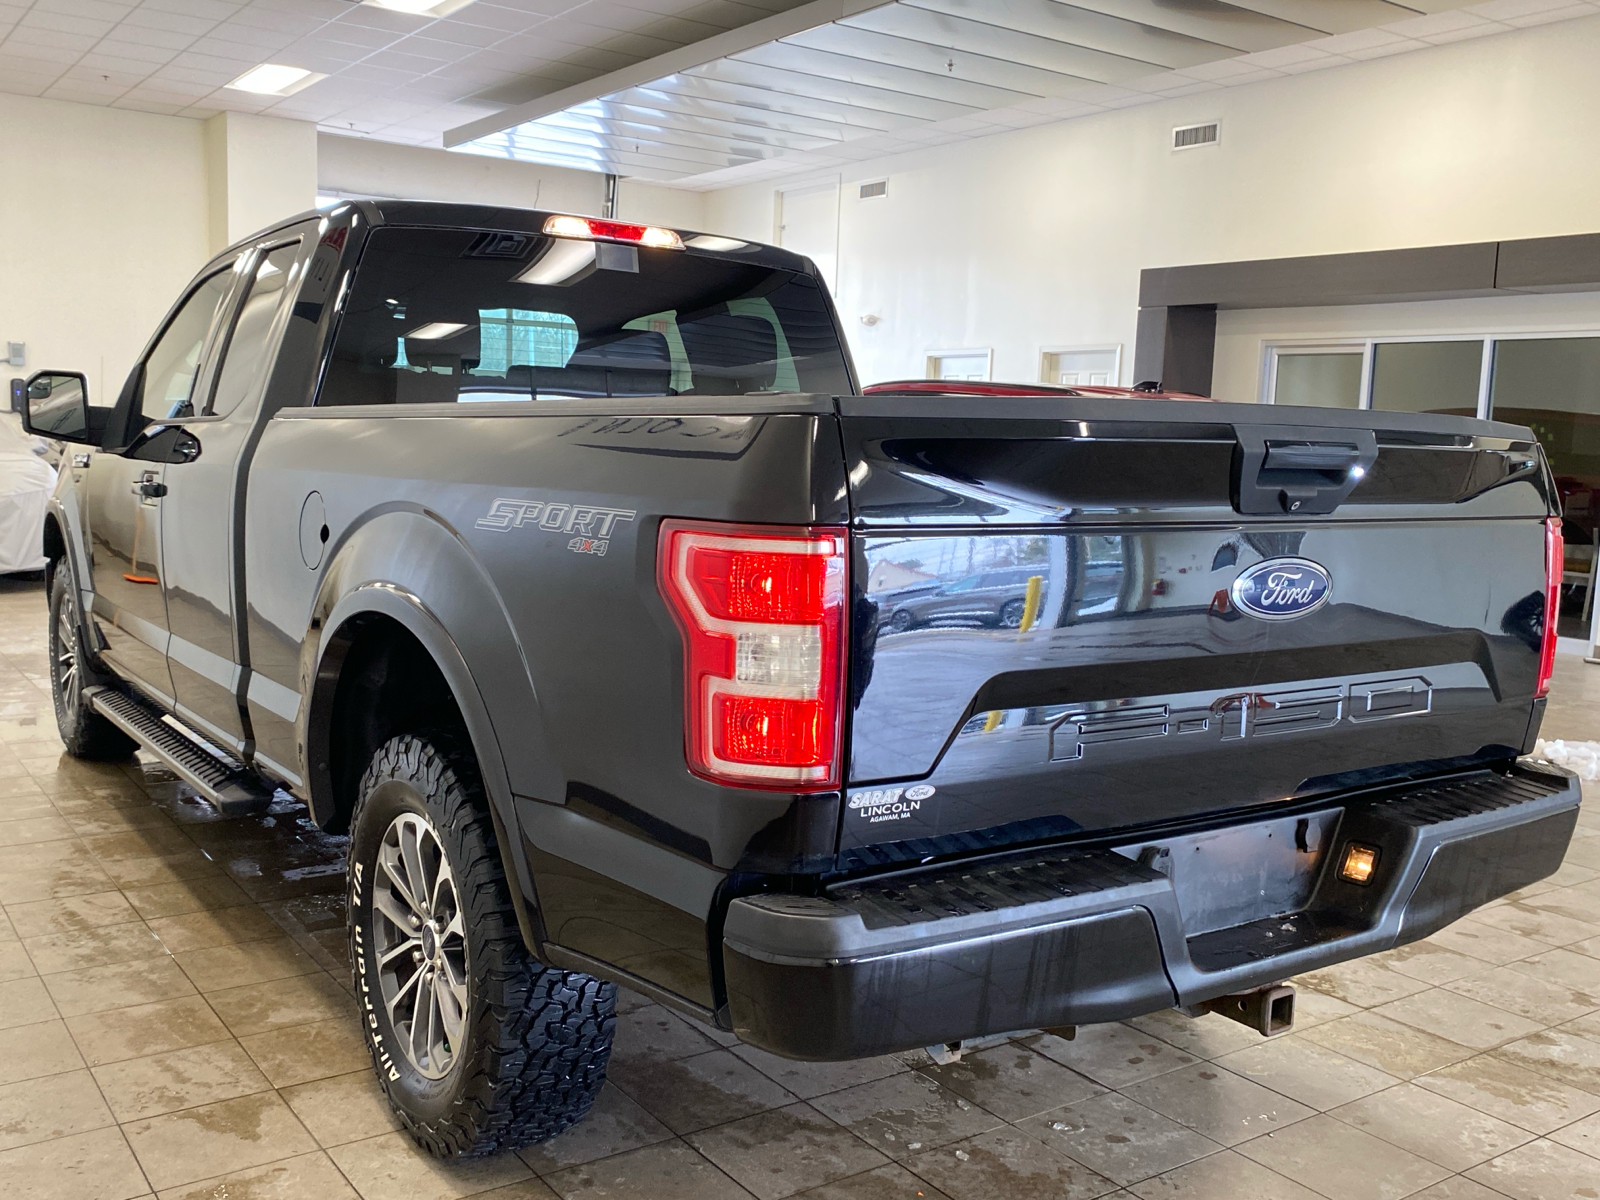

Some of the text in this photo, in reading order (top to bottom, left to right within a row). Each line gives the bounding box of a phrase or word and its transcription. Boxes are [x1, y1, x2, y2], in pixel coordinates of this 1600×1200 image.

[474, 498, 637, 538] SPORT
[1261, 572, 1315, 606] Ford
[1049, 675, 1433, 763] F-150
[848, 788, 904, 809] SARAT
[860, 801, 921, 817] LINCOLN
[869, 812, 900, 823] AGAWAM,
[353, 862, 401, 1082] All-Terrain T/A
